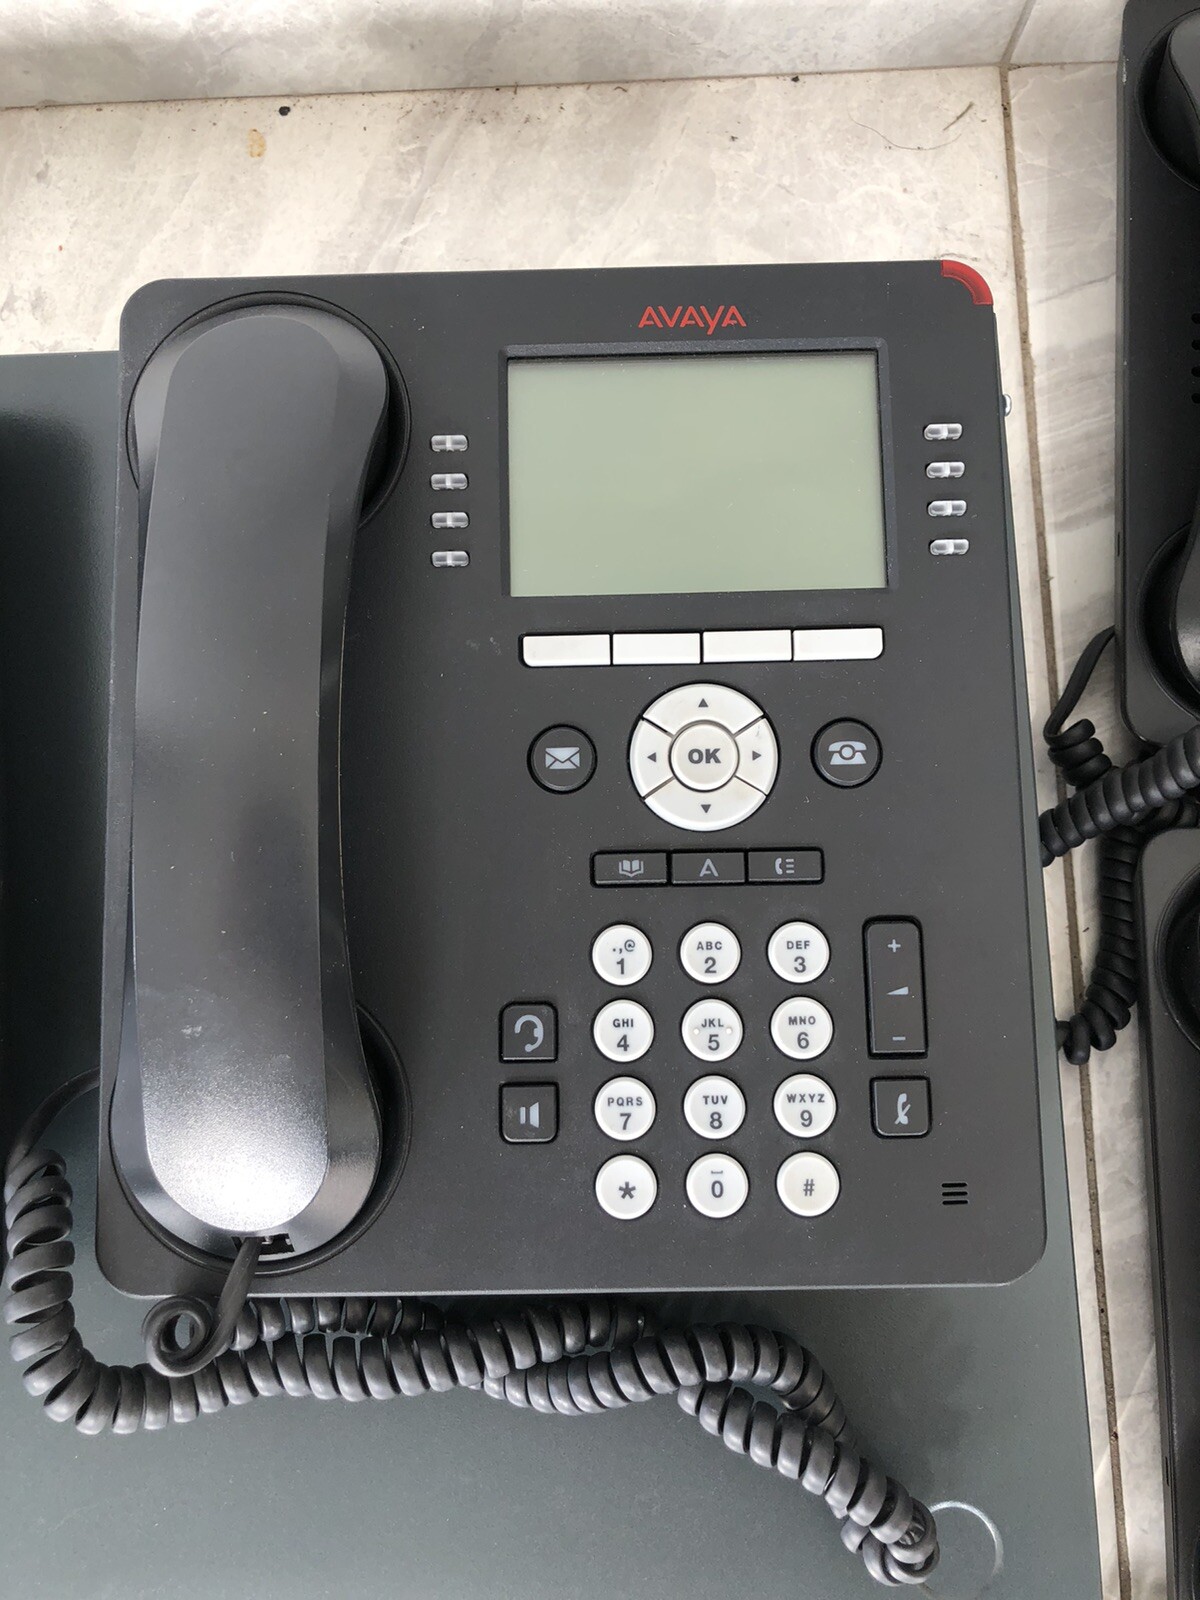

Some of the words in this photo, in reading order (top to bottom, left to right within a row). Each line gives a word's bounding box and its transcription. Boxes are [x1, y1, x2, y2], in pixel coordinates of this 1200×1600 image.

[637, 305, 747, 336] AVAYA
[687, 747, 722, 765] OK
[696, 940, 723, 951] ABC
[786, 940, 810, 950] DEF
[615, 957, 625, 976] 1
[704, 956, 717, 974] 2
[793, 955, 807, 974] 3
[612, 1018, 634, 1029] GHI
[700, 1018, 725, 1029] JKL
[788, 1015, 817, 1026] MNO
[616, 1034, 630, 1052] 4
[707, 1033, 721, 1052] 5
[796, 1031, 810, 1050] 6
[607, 1096, 643, 1107] PQRS
[702, 1095, 728, 1106] TUV
[786, 1093, 826, 1104] WXYZ
[619, 1112, 632, 1131] 7
[709, 1111, 723, 1130] 8
[799, 1109, 813, 1128] 9
[710, 1180, 724, 1199] 0
[802, 1178, 816, 1197] #
